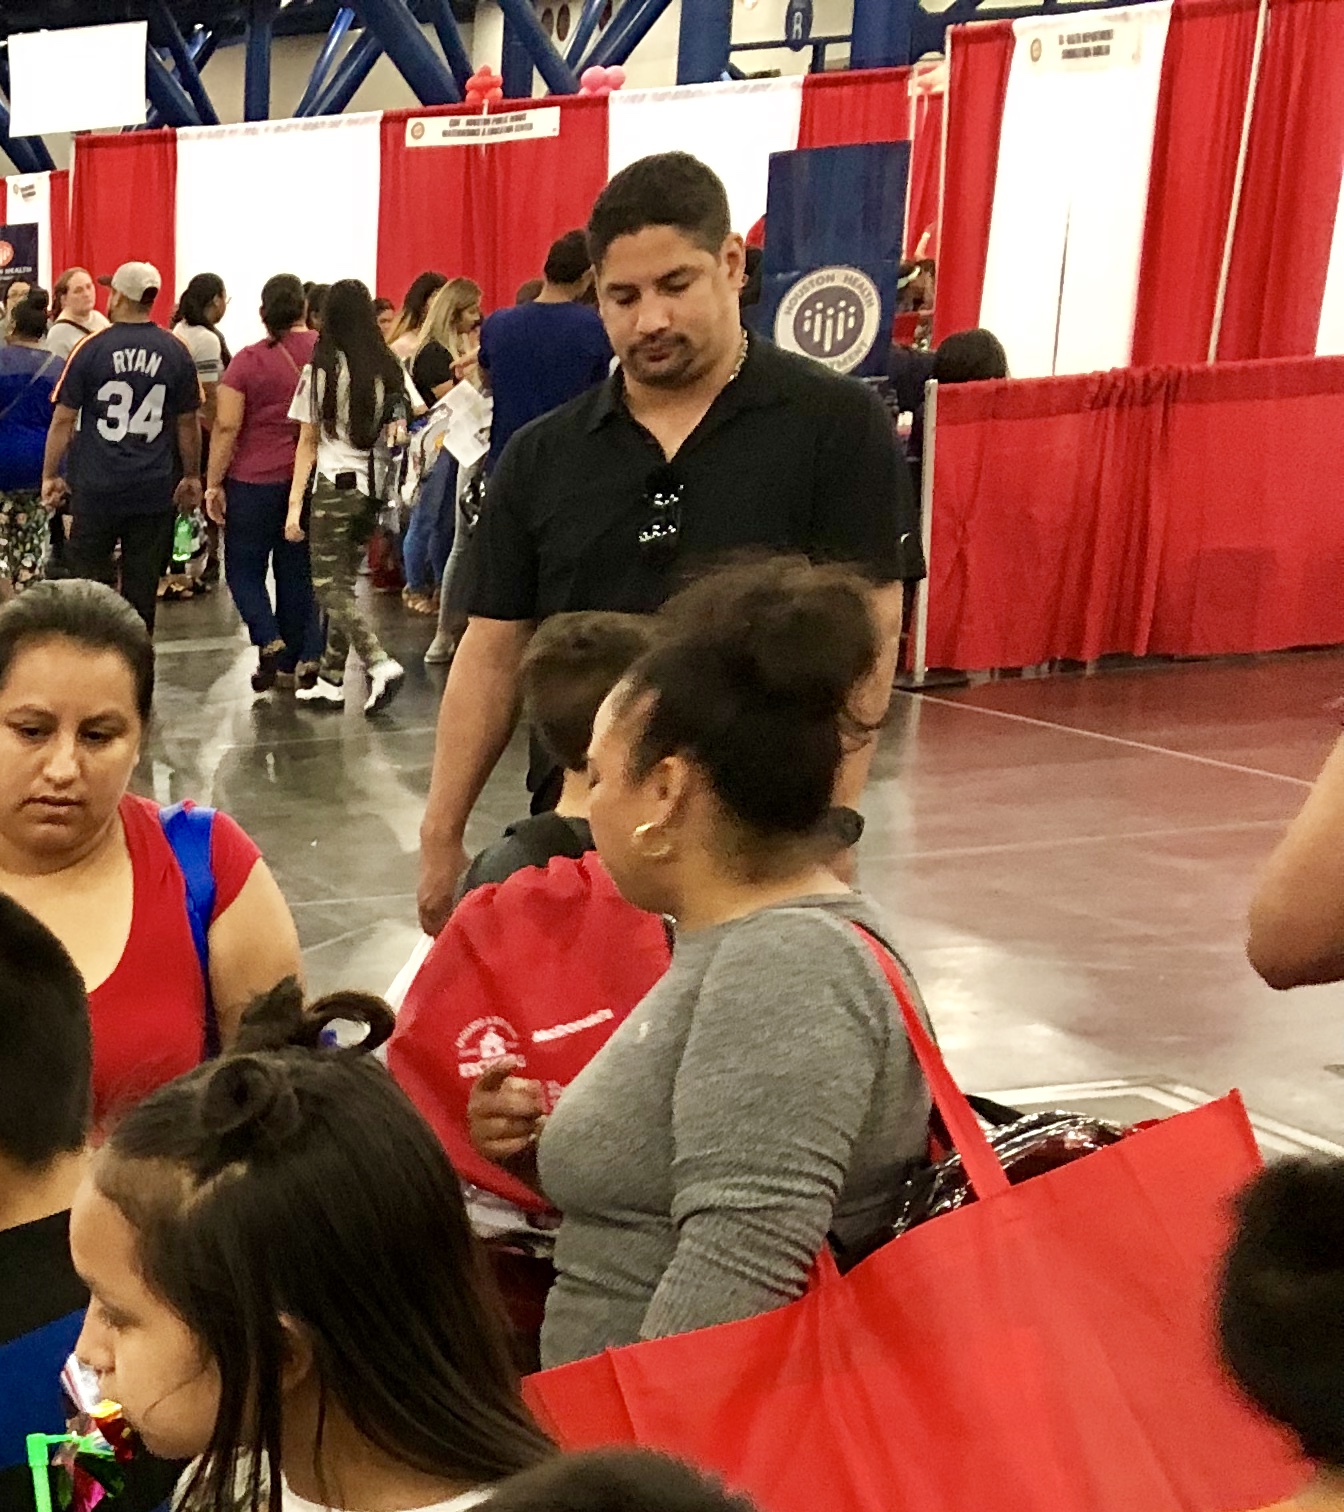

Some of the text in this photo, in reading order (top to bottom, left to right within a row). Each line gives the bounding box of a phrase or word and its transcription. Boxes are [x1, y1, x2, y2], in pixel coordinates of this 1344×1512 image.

[792, 11, 803, 39] R
[784, 273, 875, 316] HOUSTON HEALTH
[112, 348, 162, 378] RYAN
[96, 380, 166, 443] 34
